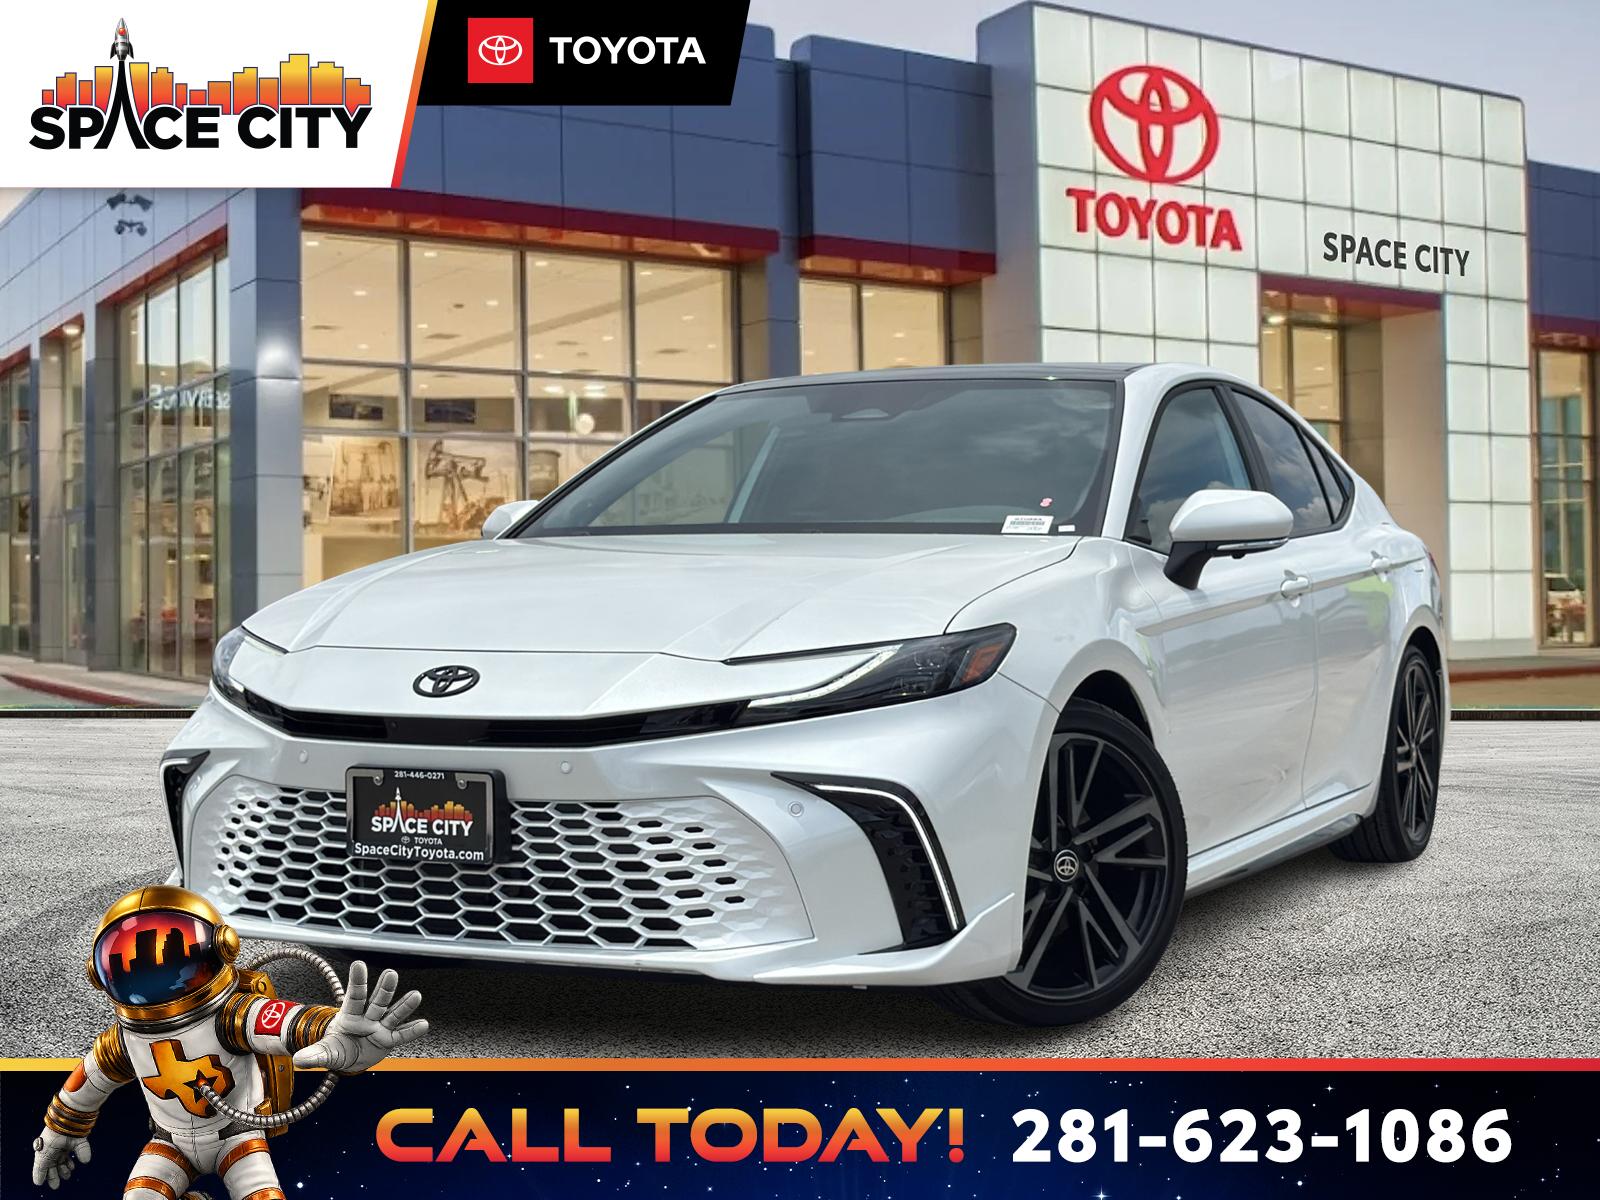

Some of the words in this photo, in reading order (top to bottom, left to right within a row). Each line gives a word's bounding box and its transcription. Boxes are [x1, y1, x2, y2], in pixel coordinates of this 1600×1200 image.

[1066, 187, 1242, 251] TOYOTA
[1322, 231, 1407, 270] SPACE
[1414, 244, 1470, 277] CITY
[394, 770, 445, 780] 281-446-0271
[371, 812, 428, 834] SPACE
[432, 818, 473, 836] CITY
[354, 842, 484, 861] SpaceCityToyota.com
[414, 836, 443, 846] TOYOTA
